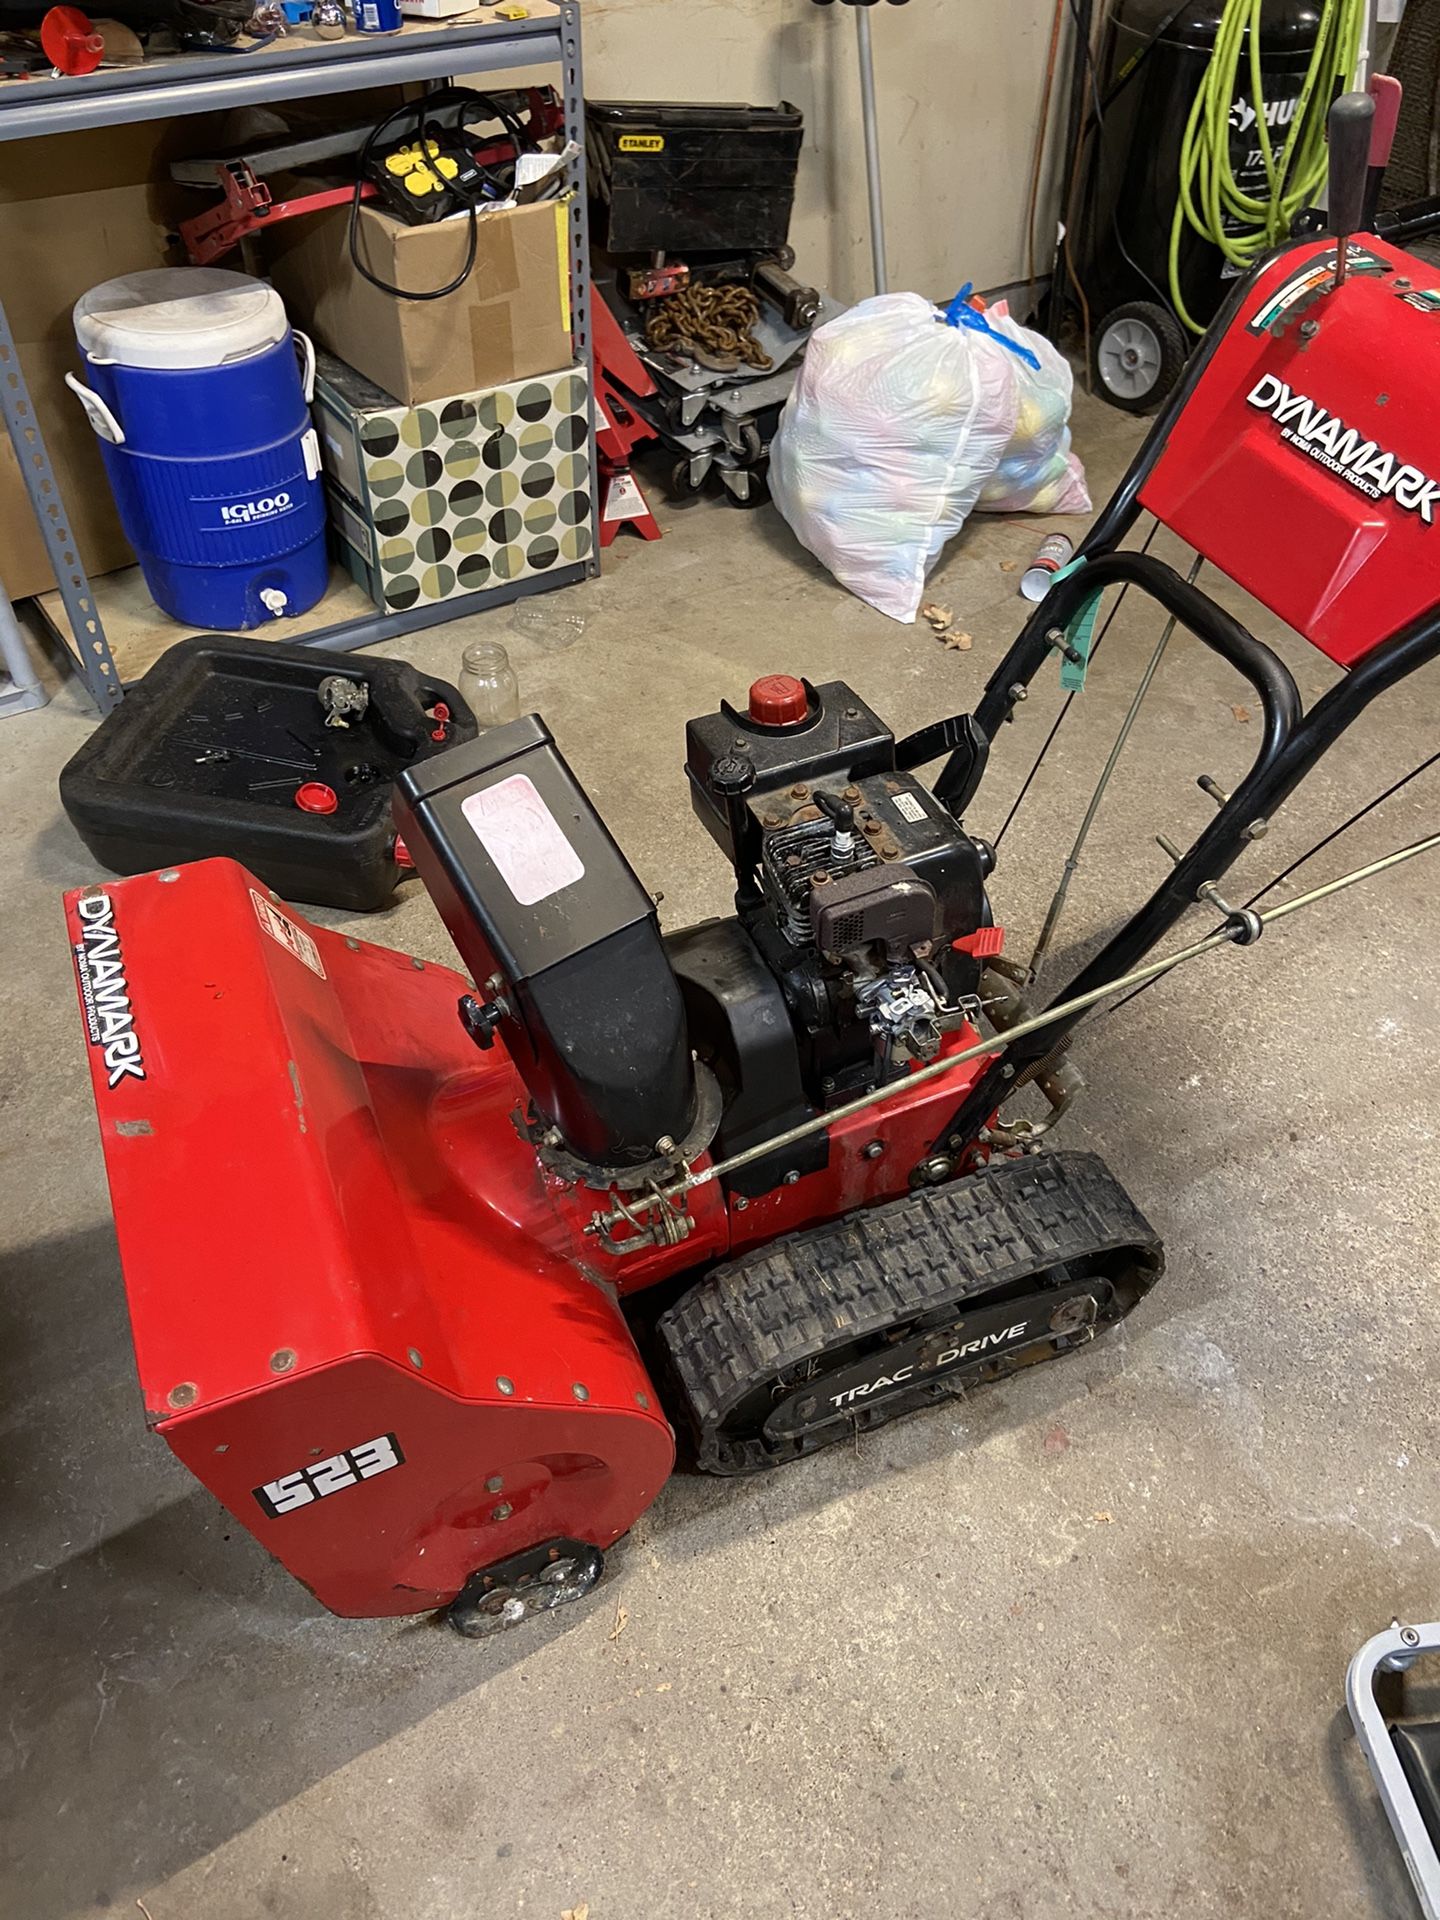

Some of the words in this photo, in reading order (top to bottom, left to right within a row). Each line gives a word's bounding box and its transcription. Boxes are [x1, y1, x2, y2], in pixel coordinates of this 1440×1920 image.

[622, 138, 661, 148] STANLEY
[1246, 373, 1440, 522] DYNAMARK
[1280, 427, 1293, 438] BY
[1289, 434, 1311, 453] NOMA
[1309, 447, 1345, 475] OUTDOOR
[1341, 469, 1381, 498] PRODUCTS
[221, 492, 290, 522] IGLOO
[75, 943, 85, 954] BY
[78, 894, 144, 1088] DYNAMARK
[81, 973, 93, 1005] OUTDOOR
[86, 1004, 100, 1042] PRODUCTS
[829, 1365, 914, 1407] TRAC
[936, 1321, 1028, 1366] DRIVE
[262, 1436, 399, 1514] 523
